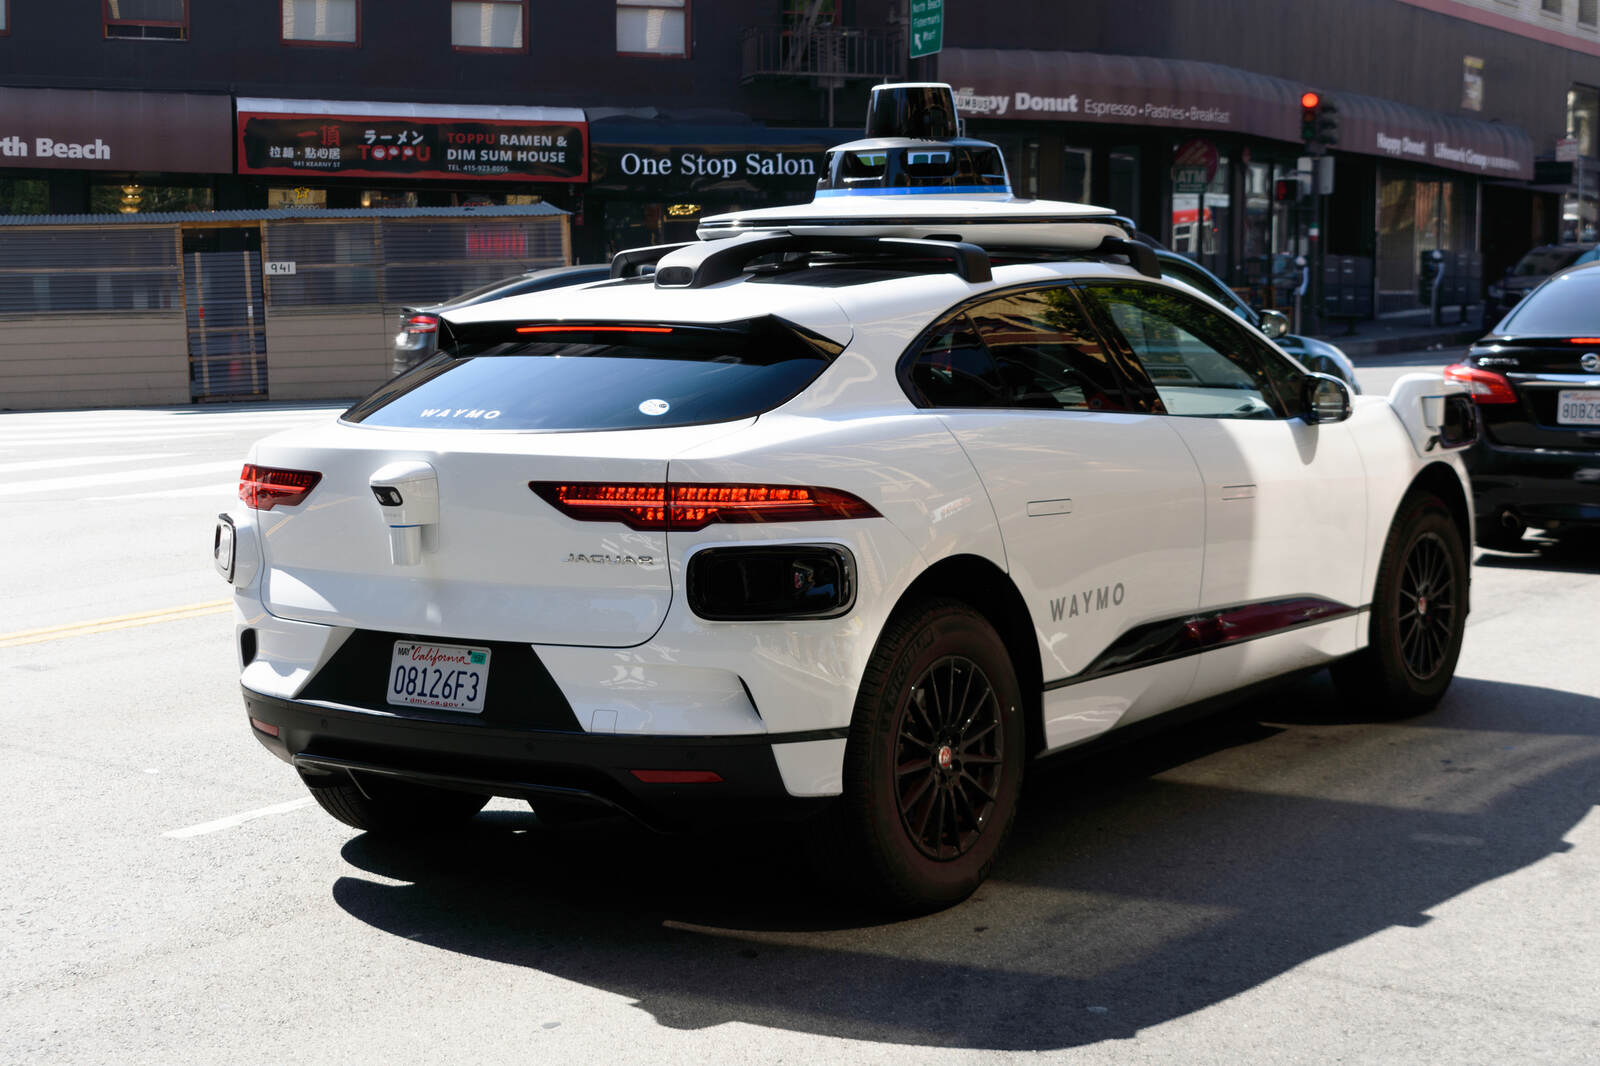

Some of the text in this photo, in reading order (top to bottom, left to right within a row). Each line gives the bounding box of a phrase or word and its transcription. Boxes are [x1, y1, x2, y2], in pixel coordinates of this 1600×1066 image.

[1015, 92, 1078, 113] Donut
[1084, 99, 1137, 117] Espresso
[364, 129, 424, 145] ラーメン
[447, 132, 568, 147] TOPPU RAMEN &
[36, 137, 111, 160] Beach
[357, 144, 431, 162] TOPPU
[447, 149, 566, 163] DIM SUM HOUSE
[621, 153, 816, 178] One Stop Salon
[270, 263, 291, 273] 941
[420, 408, 501, 420] WAYMO
[566, 552, 655, 566] JAGUAR
[1050, 582, 1125, 622] WAYMO
[398, 647, 411, 656] MAY
[411, 646, 471, 667] California
[393, 665, 480, 702] 08126F3
[409, 697, 459, 708] dmv.ca.gov
